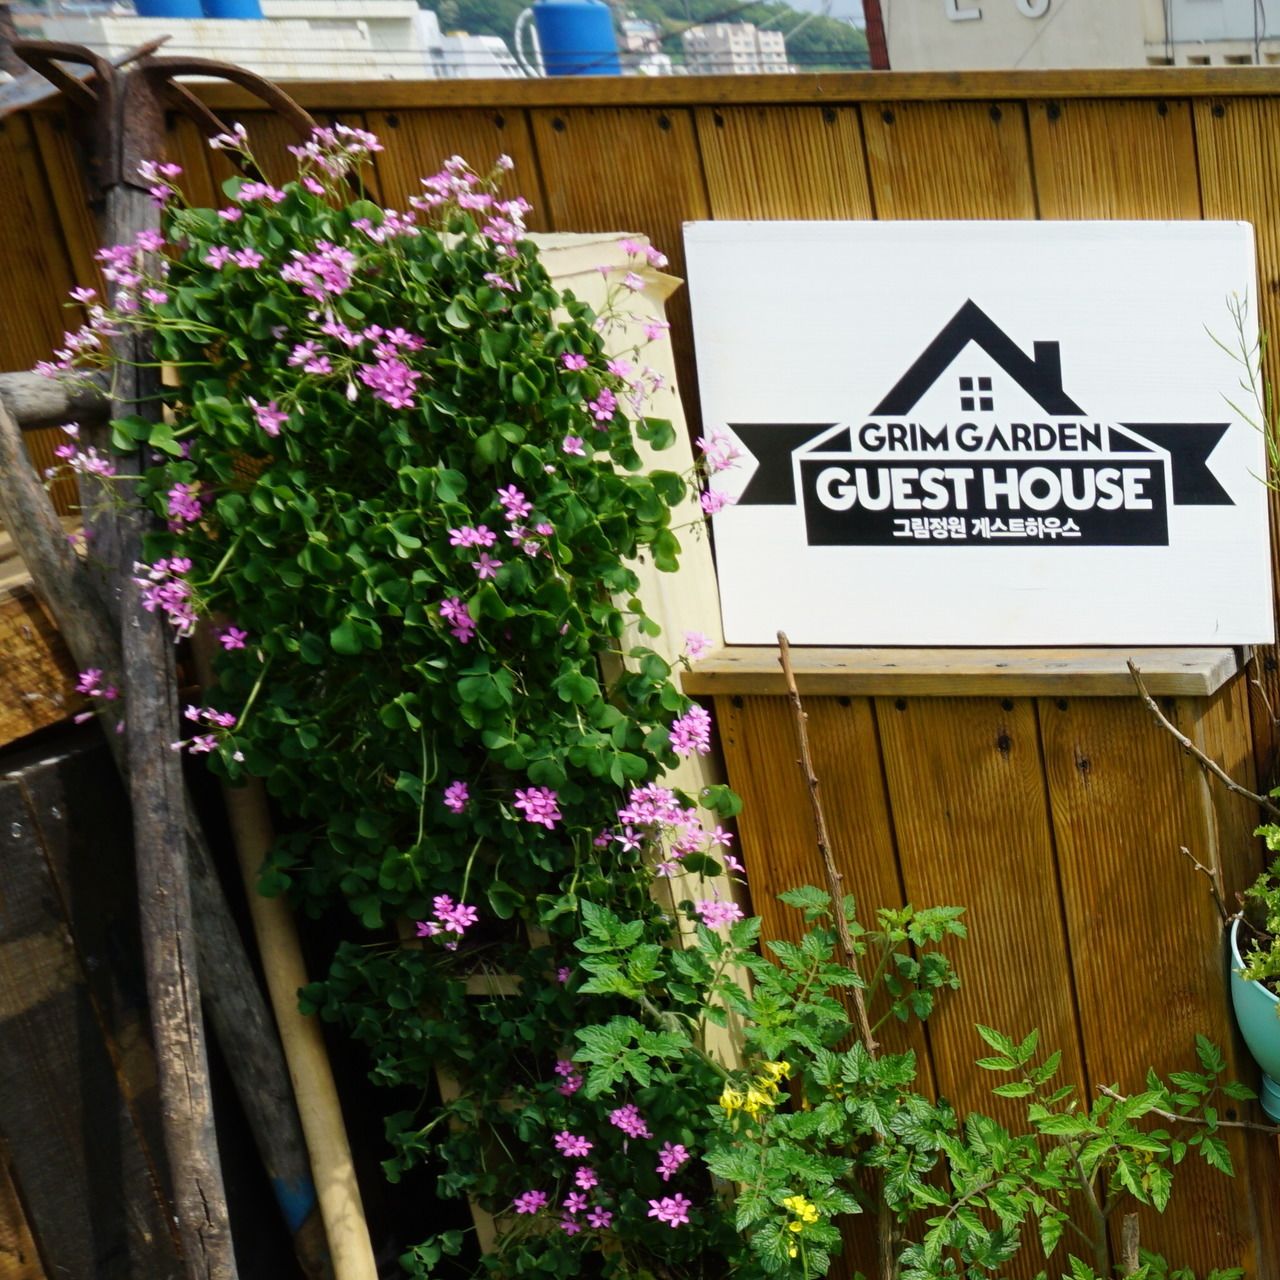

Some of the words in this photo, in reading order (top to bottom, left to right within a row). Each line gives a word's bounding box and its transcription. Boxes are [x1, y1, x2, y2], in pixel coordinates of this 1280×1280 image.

[858, 422, 950, 452] GRIM
[955, 422, 1103, 452] GARDEN
[815, 466, 974, 511] GUEST
[982, 466, 1153, 511] HOUSE
[892, 516, 967, 539] 그림정원
[971, 516, 1082, 539] 게스트하우스
